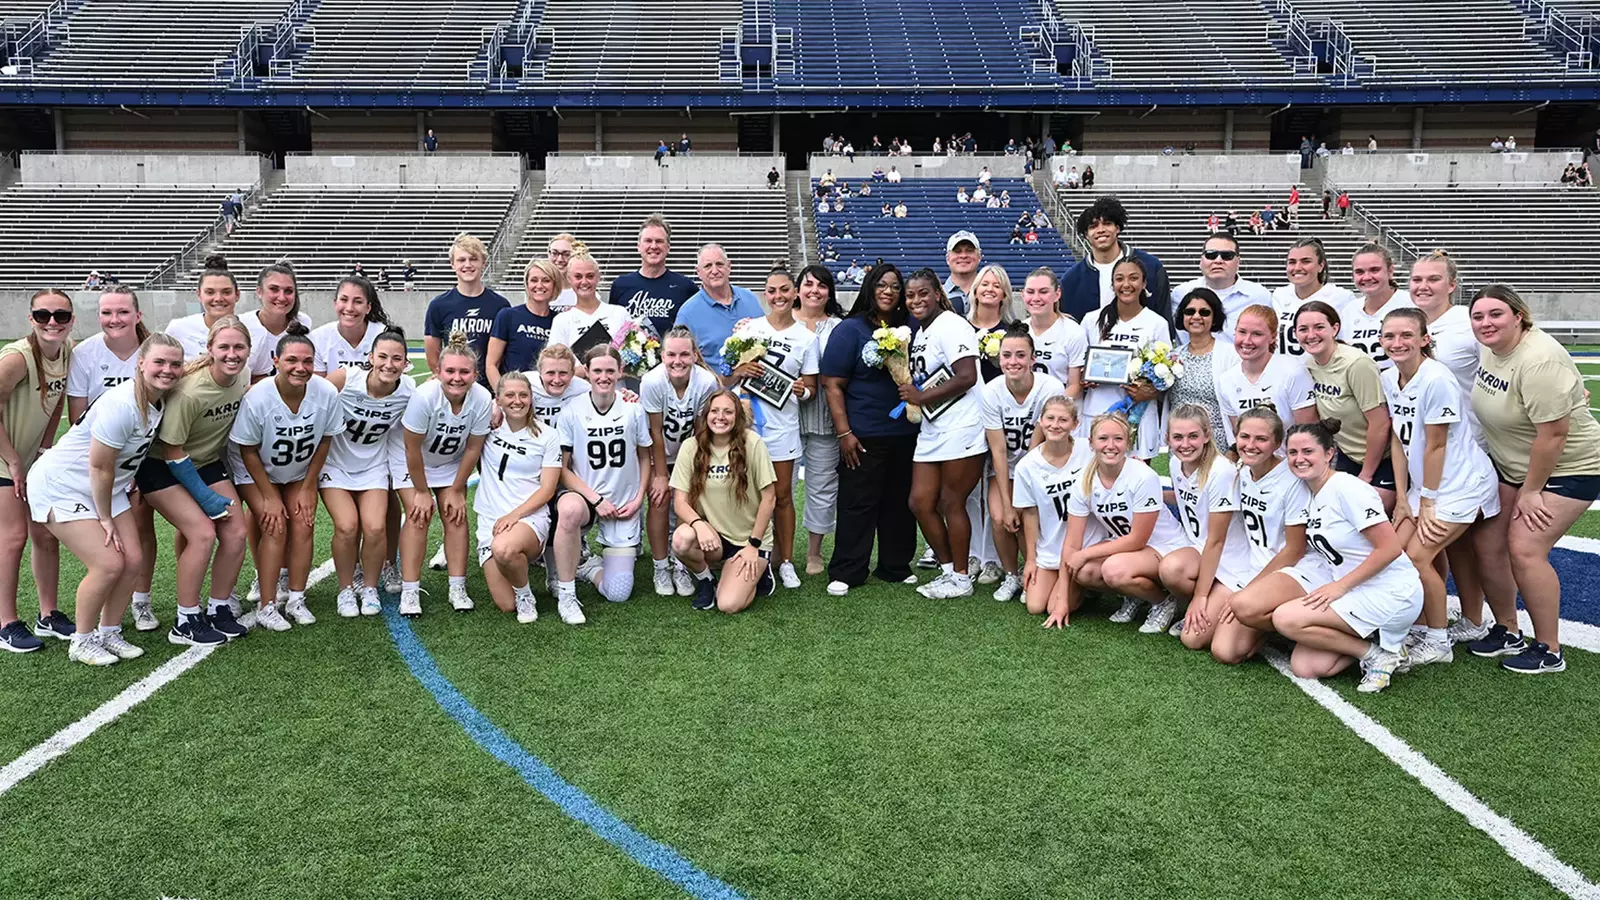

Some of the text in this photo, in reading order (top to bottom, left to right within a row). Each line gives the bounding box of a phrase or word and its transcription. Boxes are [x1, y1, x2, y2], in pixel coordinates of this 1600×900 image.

[626, 291, 675, 309] Akron
[628, 308, 670, 318] LACROSSE
[451, 318, 492, 333] AKRON
[517, 324, 550, 337] AKRO
[1034, 350, 1052, 360] PS
[203, 400, 240, 418] AKRO
[1239, 396, 1272, 409] ZIP
[353, 406, 391, 420] ZIPS
[535, 407, 561, 416] ZIP
[668, 406, 694, 418] ZIPS
[1441, 407, 1456, 417] A
[275, 424, 314, 436] ZIPS
[344, 418, 390, 444] 42
[587, 426, 624, 437] ZIPS
[663, 416, 694, 443] 22
[1004, 422, 1035, 450] 36
[271, 435, 315, 466] 35
[428, 435, 461, 455] 18
[493, 436, 527, 455] ZIPS
[587, 438, 626, 470] 99
[498, 453, 509, 481] 1
[1046, 479, 1076, 494] ZIP
[1145, 498, 1157, 507] A
[1179, 489, 1198, 505] ZIPS
[1218, 497, 1232, 507] A
[1241, 493, 1267, 512] ZIPS
[73, 503, 90, 513] A
[1097, 502, 1128, 512] ZIPS
[1365, 508, 1380, 519] A
[1102, 516, 1131, 537] 16
